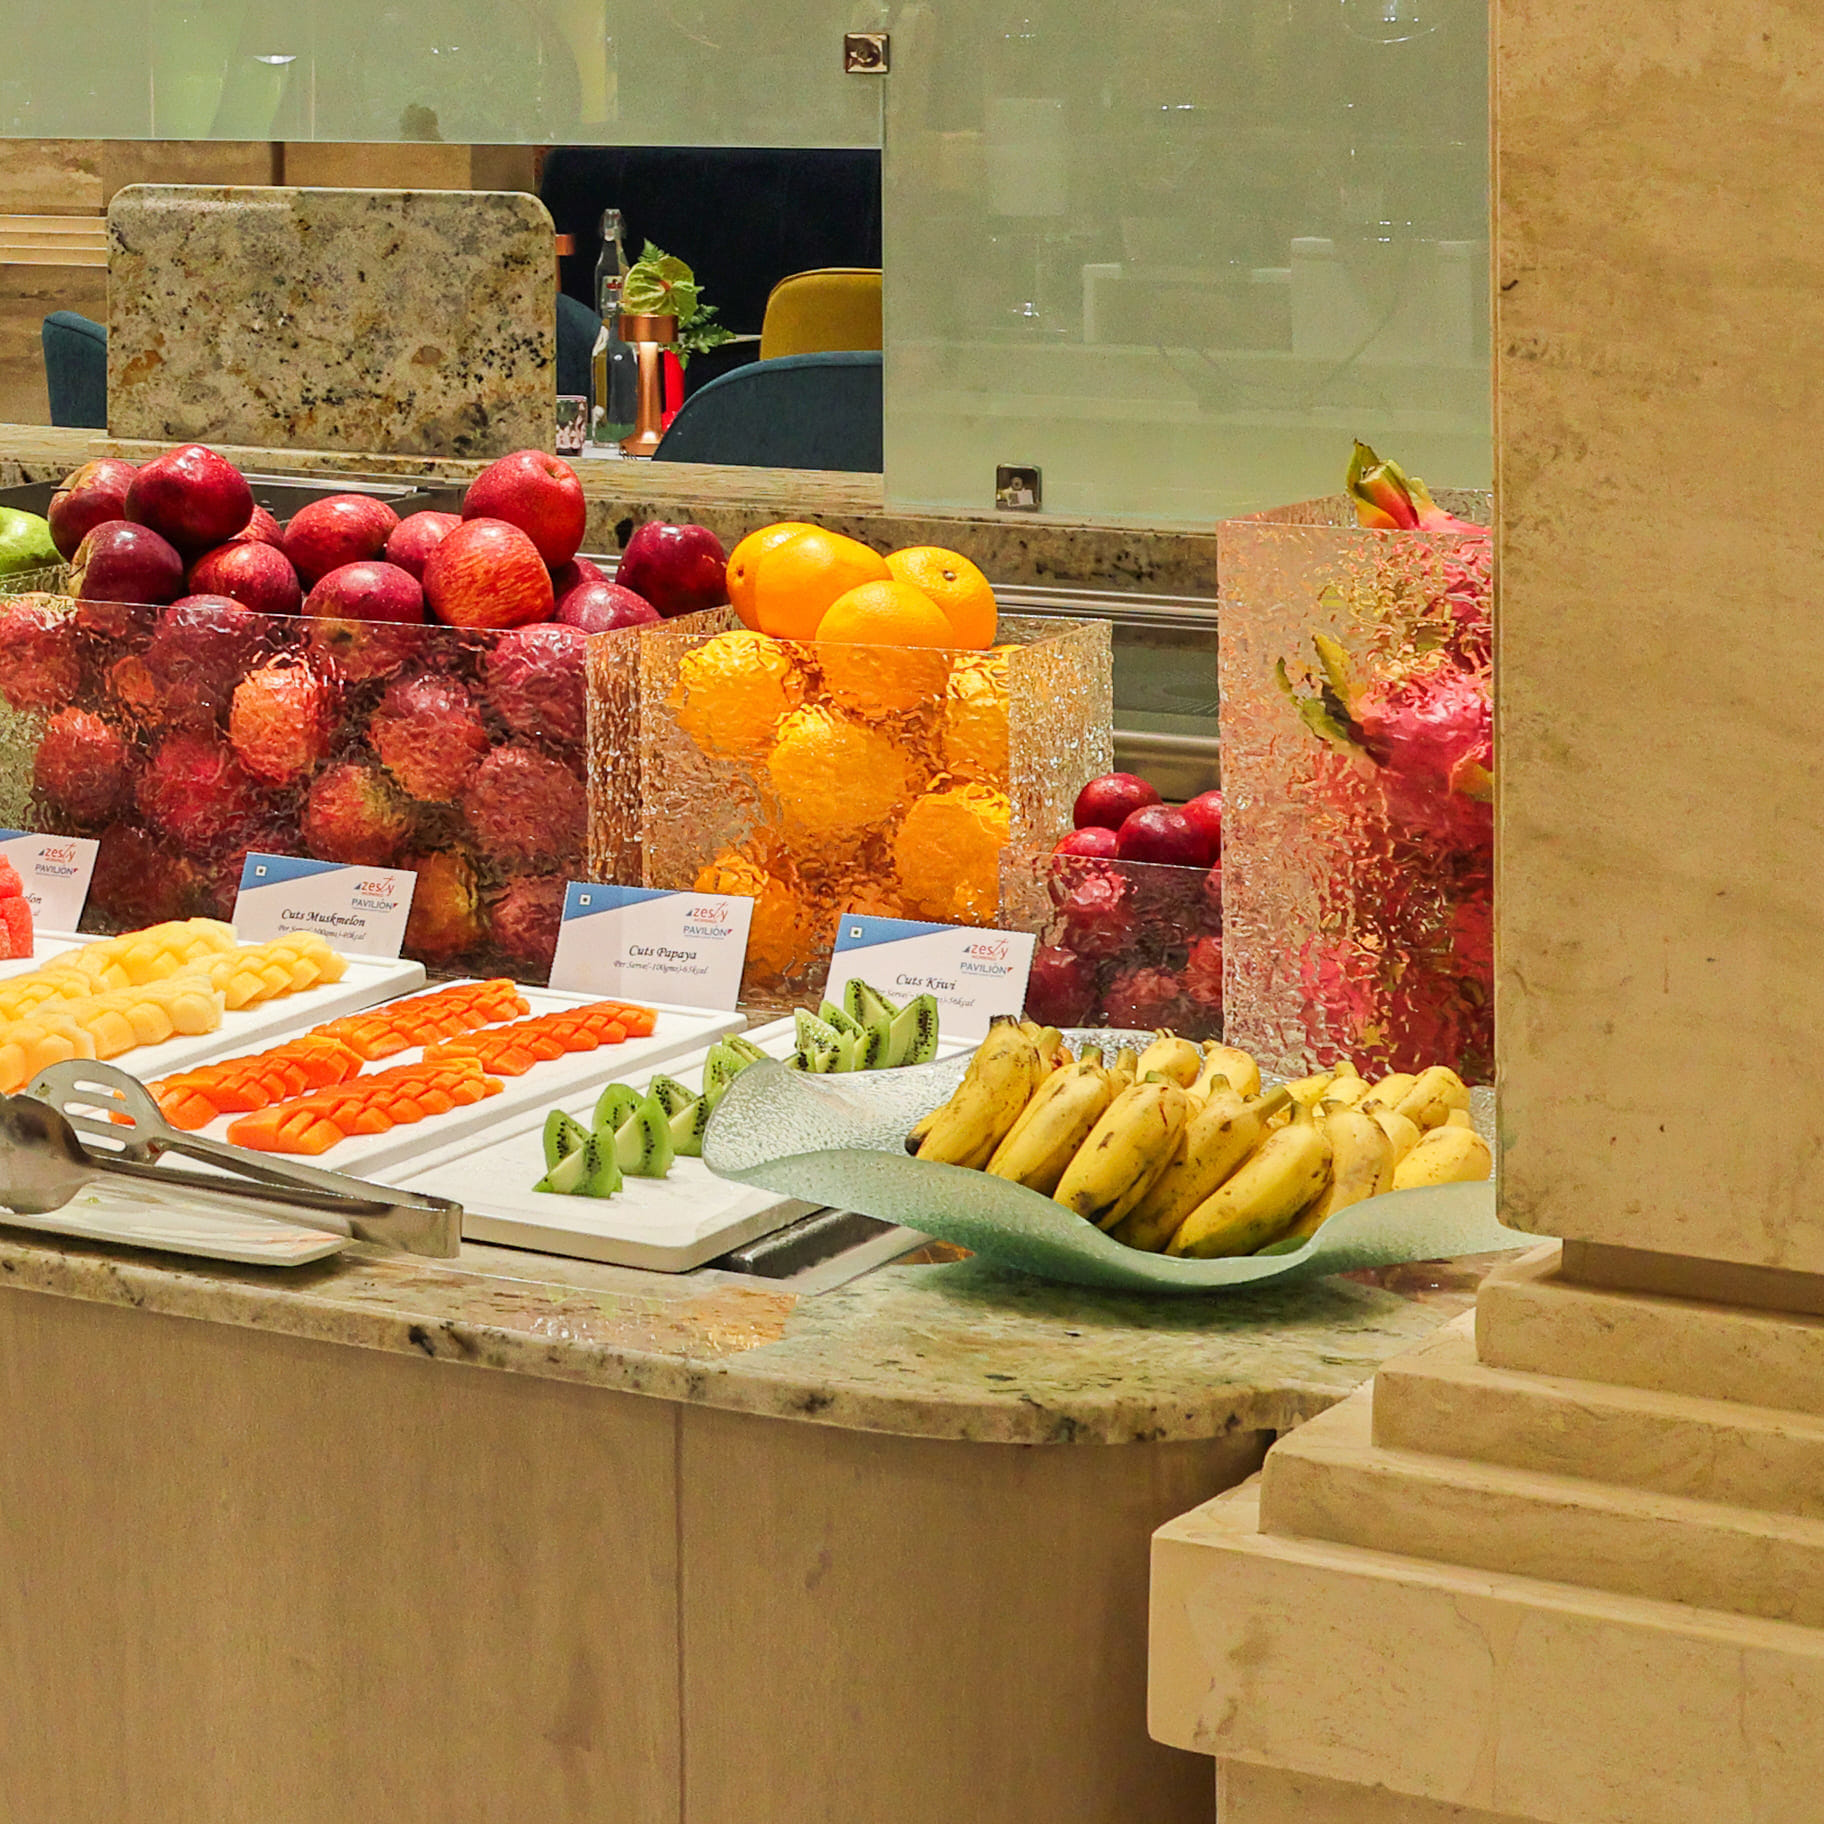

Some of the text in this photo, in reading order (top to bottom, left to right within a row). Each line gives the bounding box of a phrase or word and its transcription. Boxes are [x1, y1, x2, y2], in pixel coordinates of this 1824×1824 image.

[282, 909, 366, 927] Cuts Muskmelon
[693, 901, 728, 923] zesty
[629, 945, 697, 962] Cuts Papaya
[971, 939, 1008, 960] zesty
[896, 974, 957, 990] Cuts Kiwi
